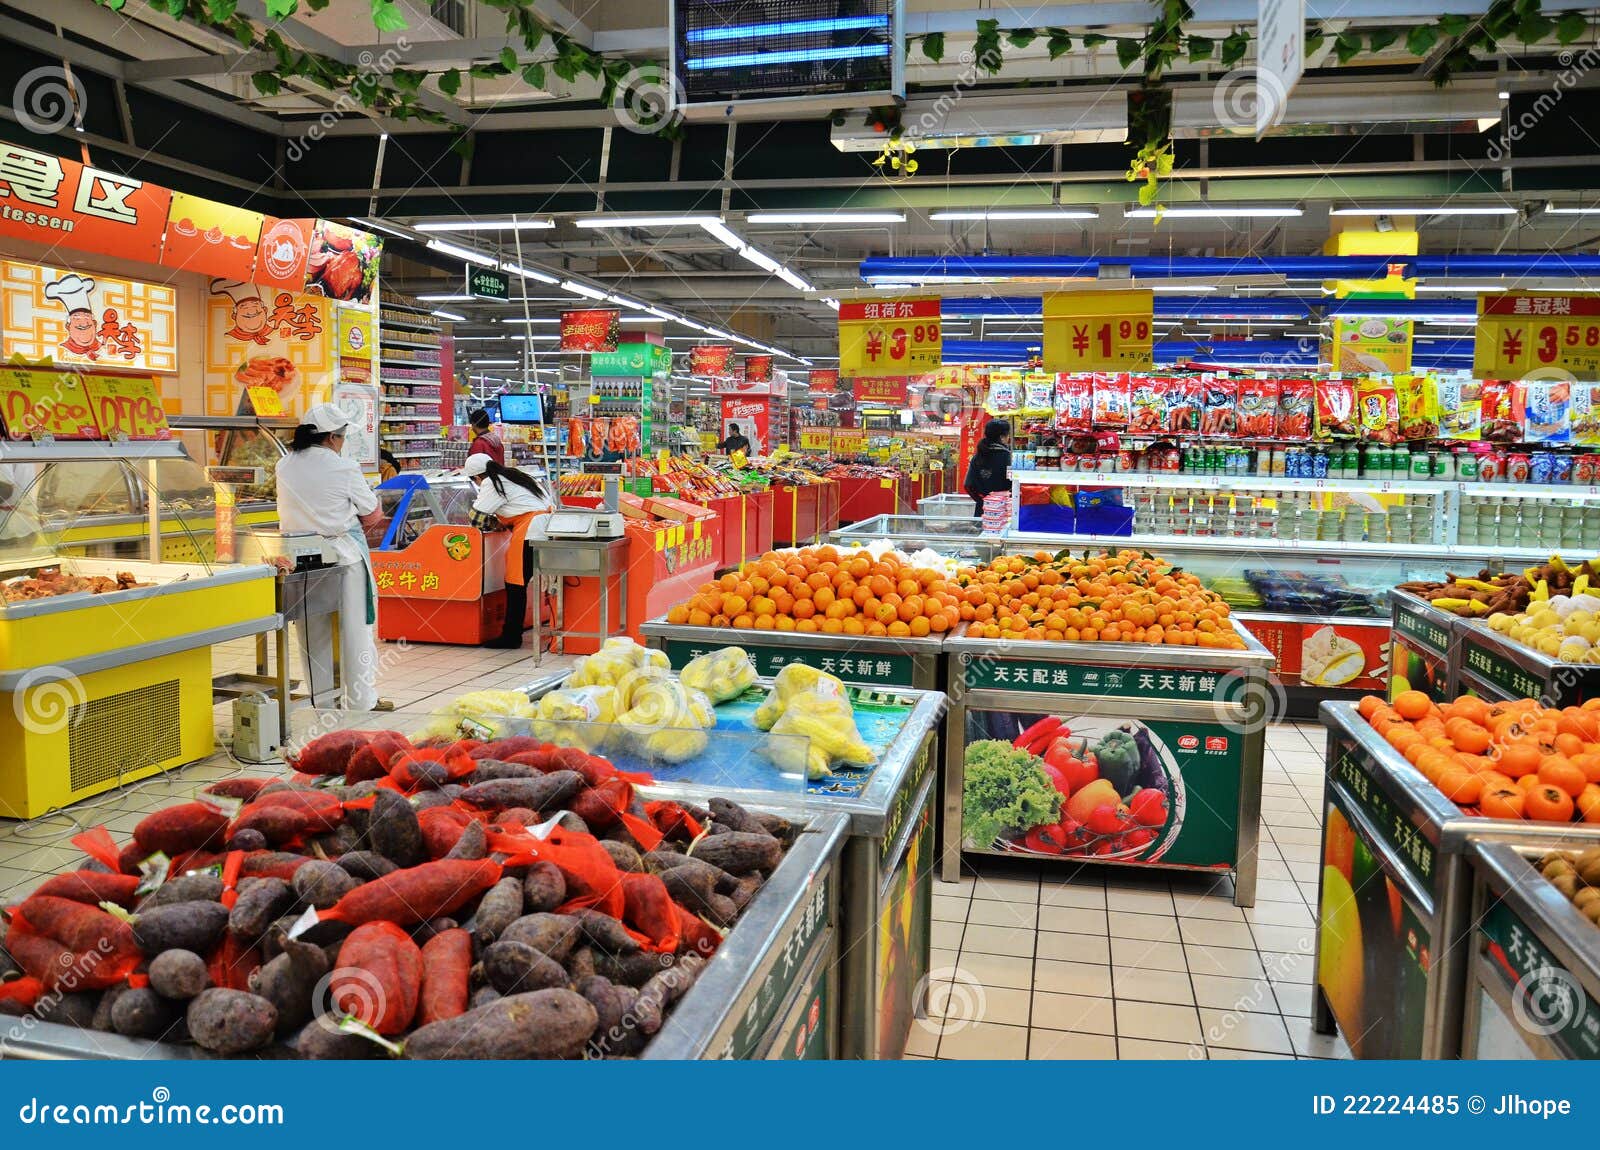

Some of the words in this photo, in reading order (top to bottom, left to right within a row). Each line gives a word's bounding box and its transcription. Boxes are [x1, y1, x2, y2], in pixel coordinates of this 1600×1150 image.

[481, 286, 499, 294] EXIT
[864, 302, 914, 318] 纽荷尔
[1513, 297, 1571, 314] 皇冠梨
[821, 657, 892, 677] 天天新鲜
[993, 666, 1069, 686] 天天配送
[1138, 674, 1216, 693] 天天新鲜
